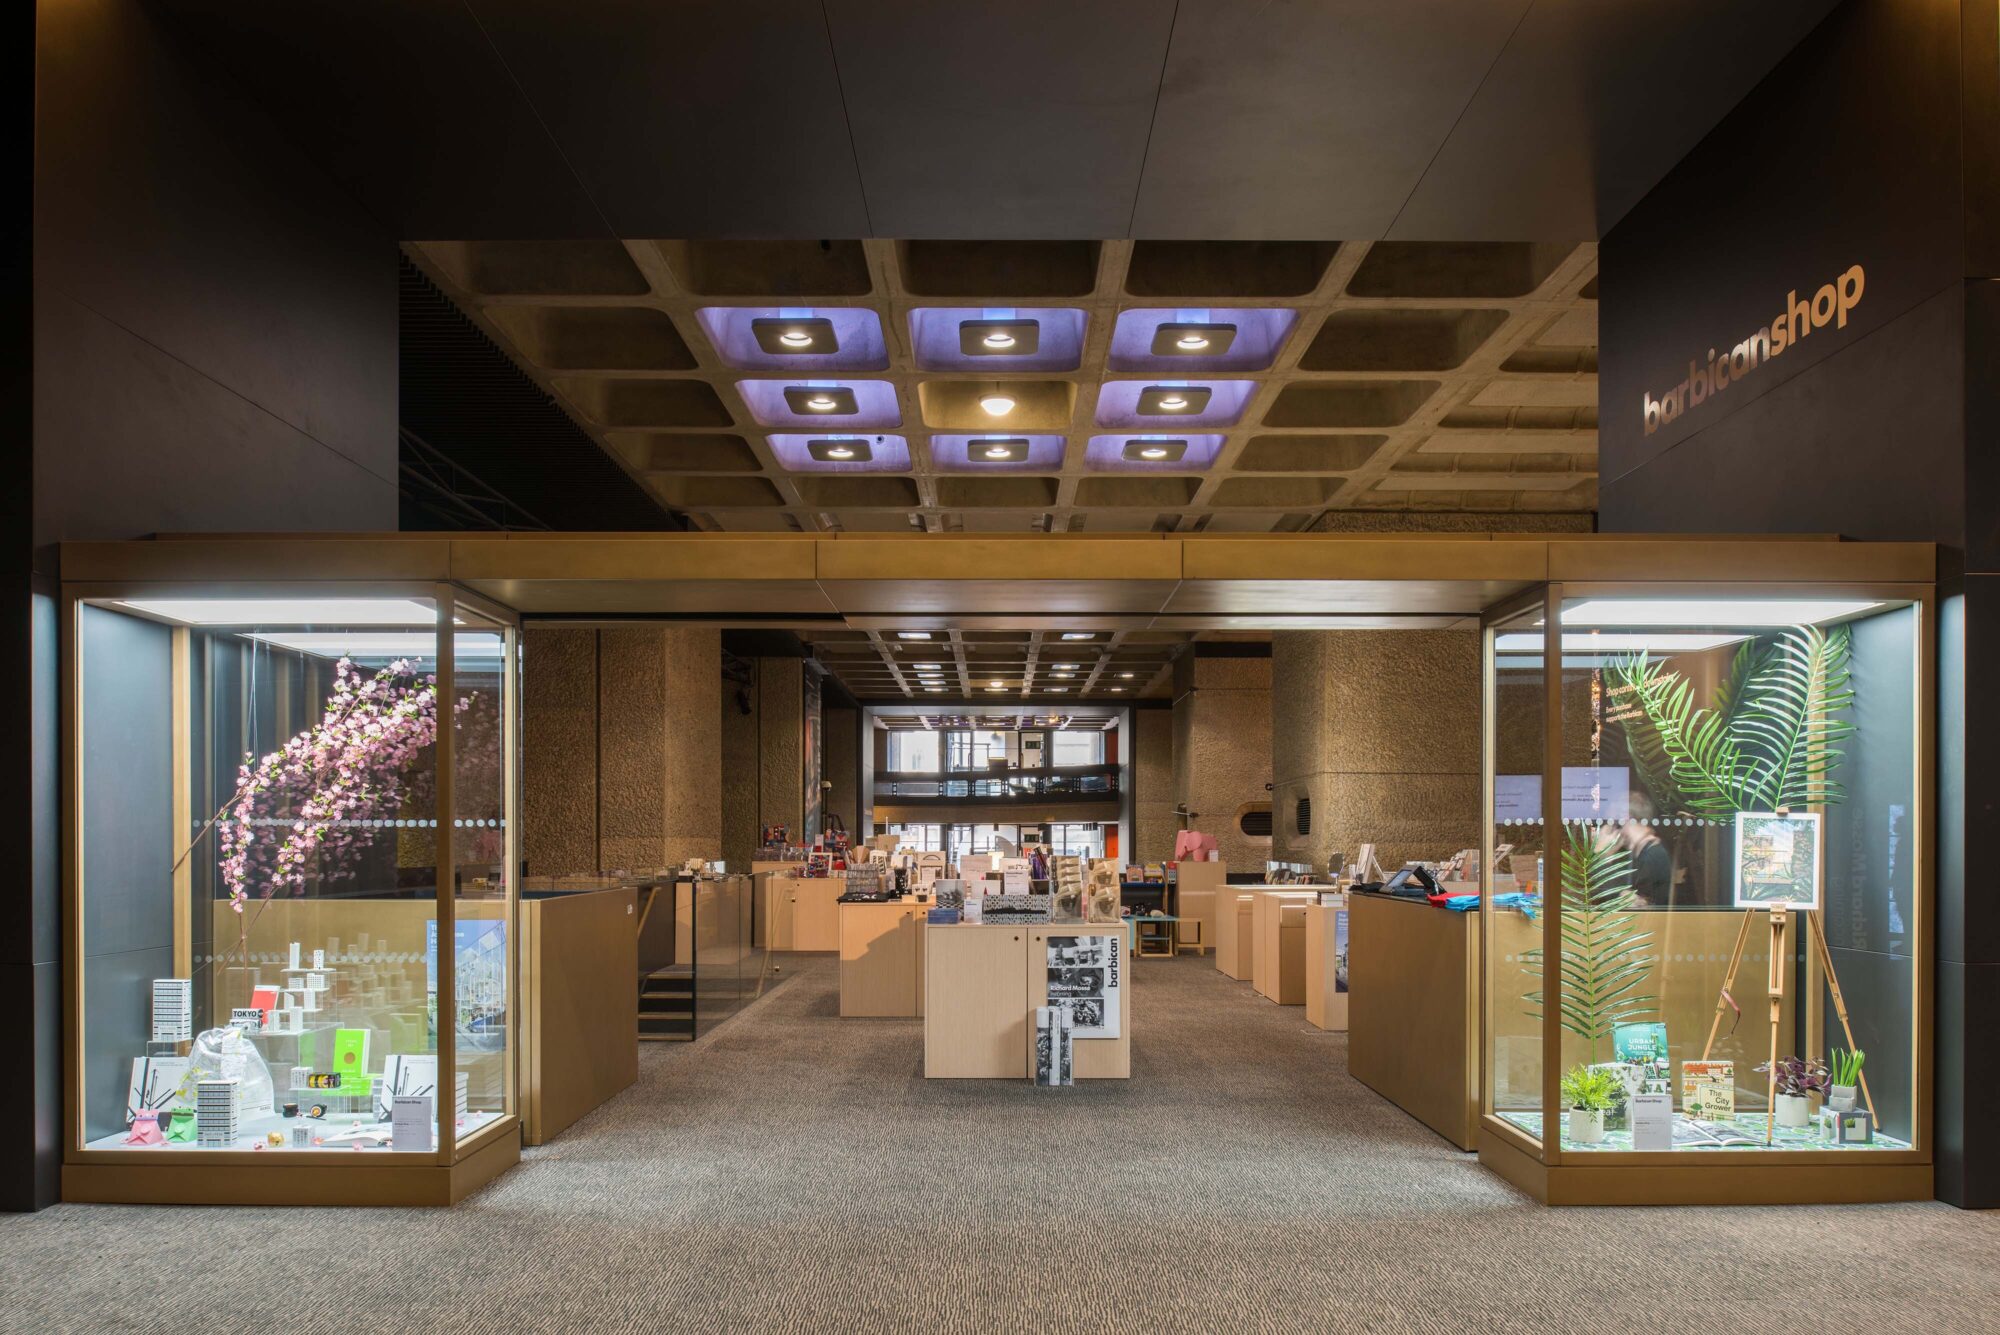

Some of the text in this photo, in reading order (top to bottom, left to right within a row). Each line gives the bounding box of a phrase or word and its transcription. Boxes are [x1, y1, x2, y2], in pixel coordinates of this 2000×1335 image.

[1643, 264, 1865, 437] barbicanshop
[1605, 687, 1619, 698] Shop
[1108, 938, 1118, 988] barbican
[233, 1010, 257, 1018] TOKYO
[1709, 1089, 1722, 1097] The
[1715, 1097, 1730, 1105] City
[1705, 1102, 1731, 1112] Grower
